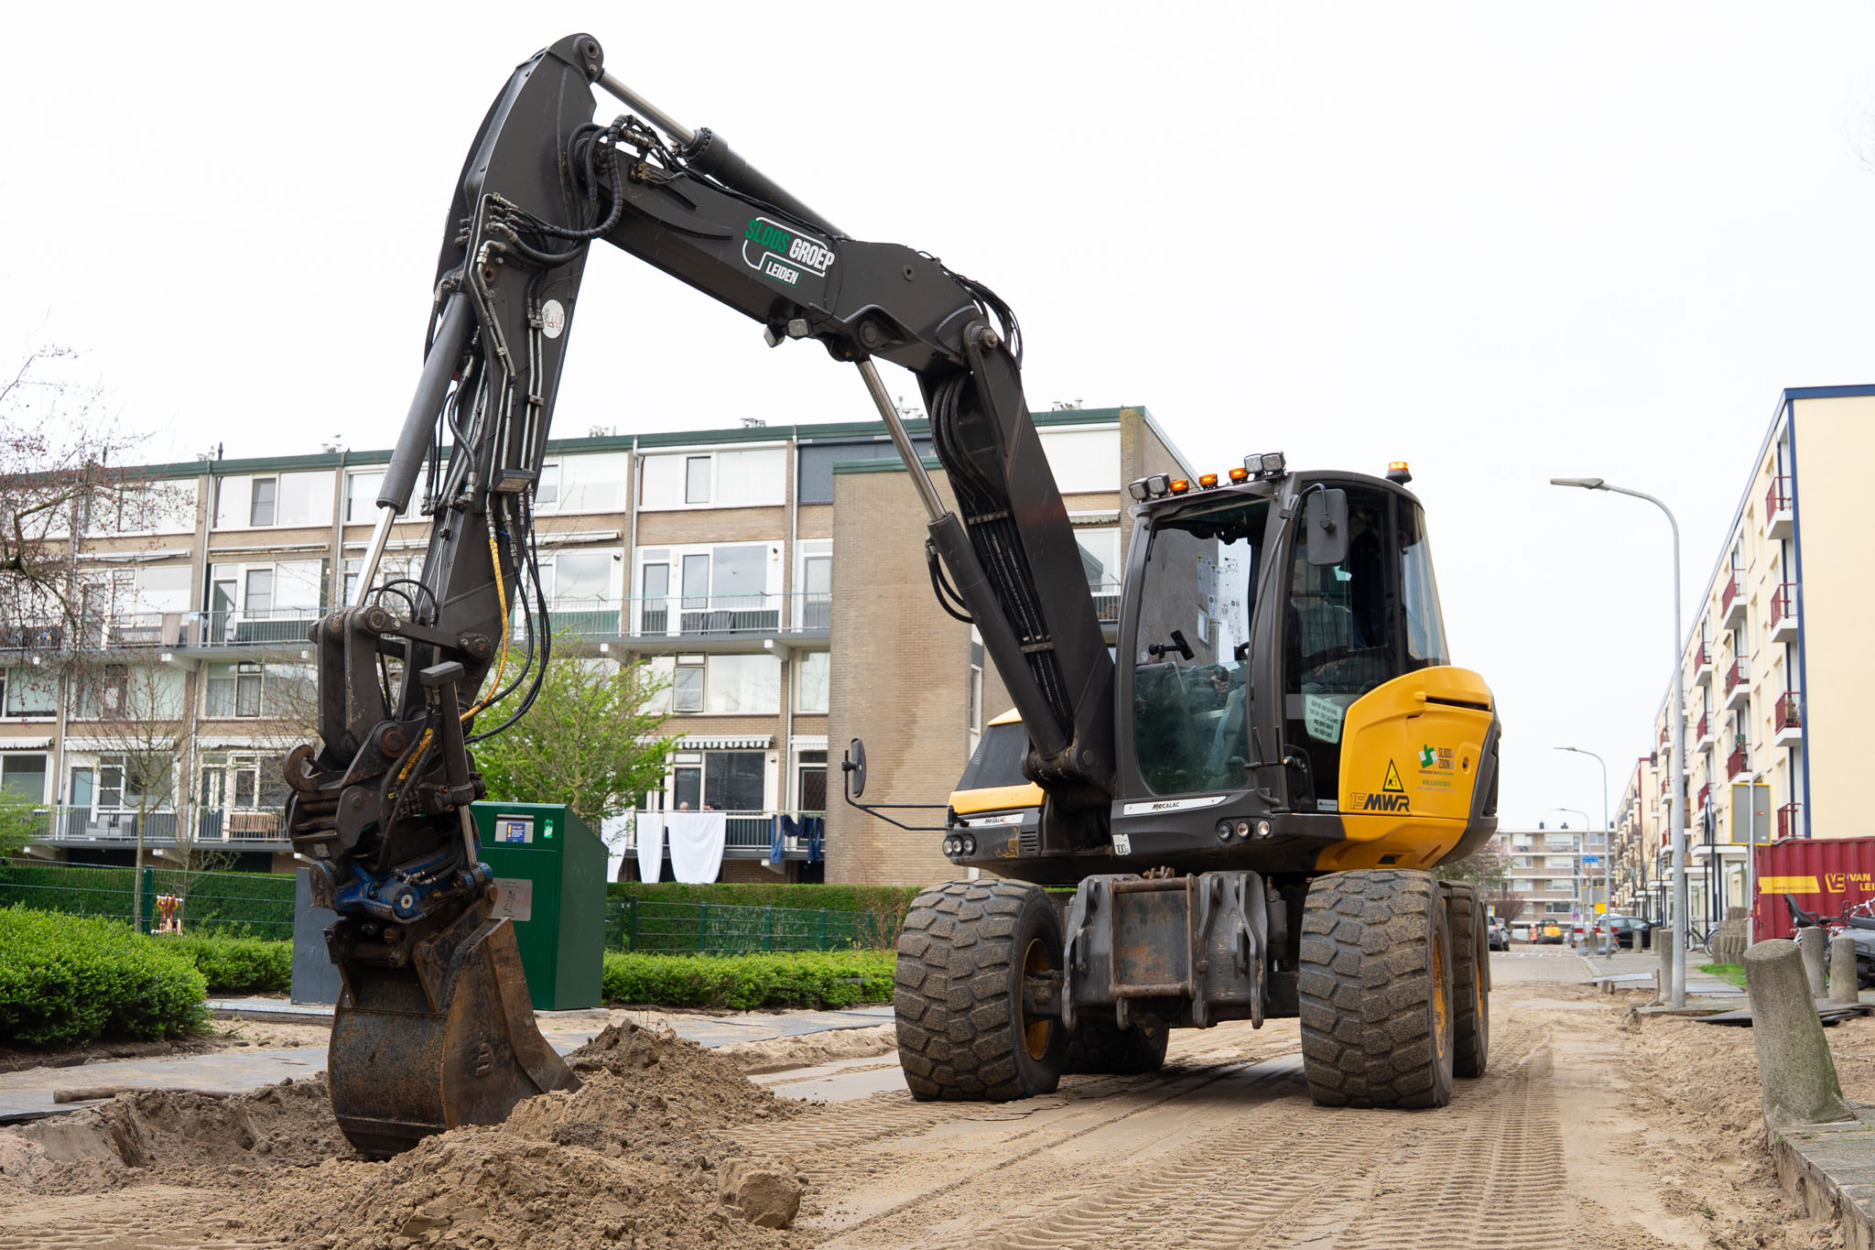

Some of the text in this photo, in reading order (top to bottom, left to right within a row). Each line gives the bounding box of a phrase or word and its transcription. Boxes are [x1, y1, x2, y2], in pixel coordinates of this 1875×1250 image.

[745, 219, 835, 271] SLOOS GROEP
[765, 261, 799, 285] LEIDEN
[1849, 873, 1871, 882] VAN
